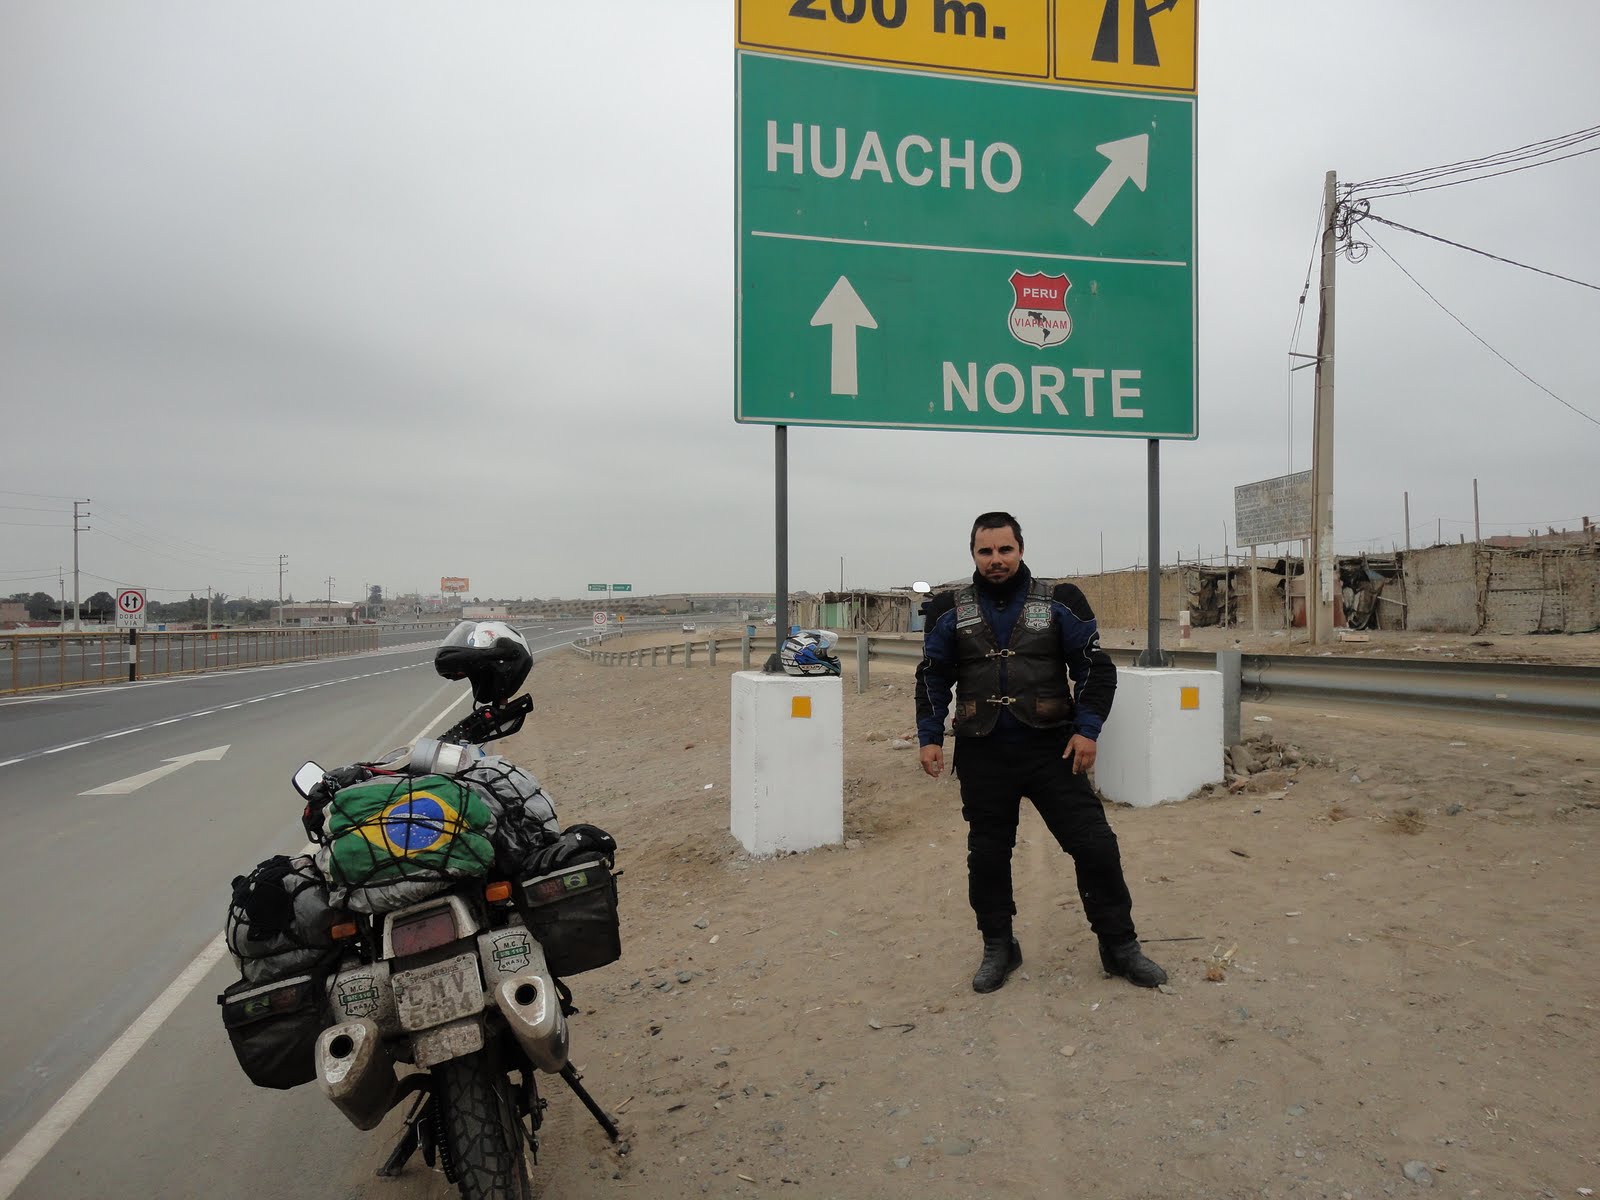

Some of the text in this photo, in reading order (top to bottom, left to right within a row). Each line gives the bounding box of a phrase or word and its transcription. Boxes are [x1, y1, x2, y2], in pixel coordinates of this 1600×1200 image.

[933, 0, 1006, 40] m.
[767, 120, 1022, 193] HUACHO
[1023, 288, 1058, 299] PERU
[1014, 318, 1068, 329] VIAPANAM
[942, 361, 1144, 418] NORTE
[501, 959, 527, 969] BRASIL
